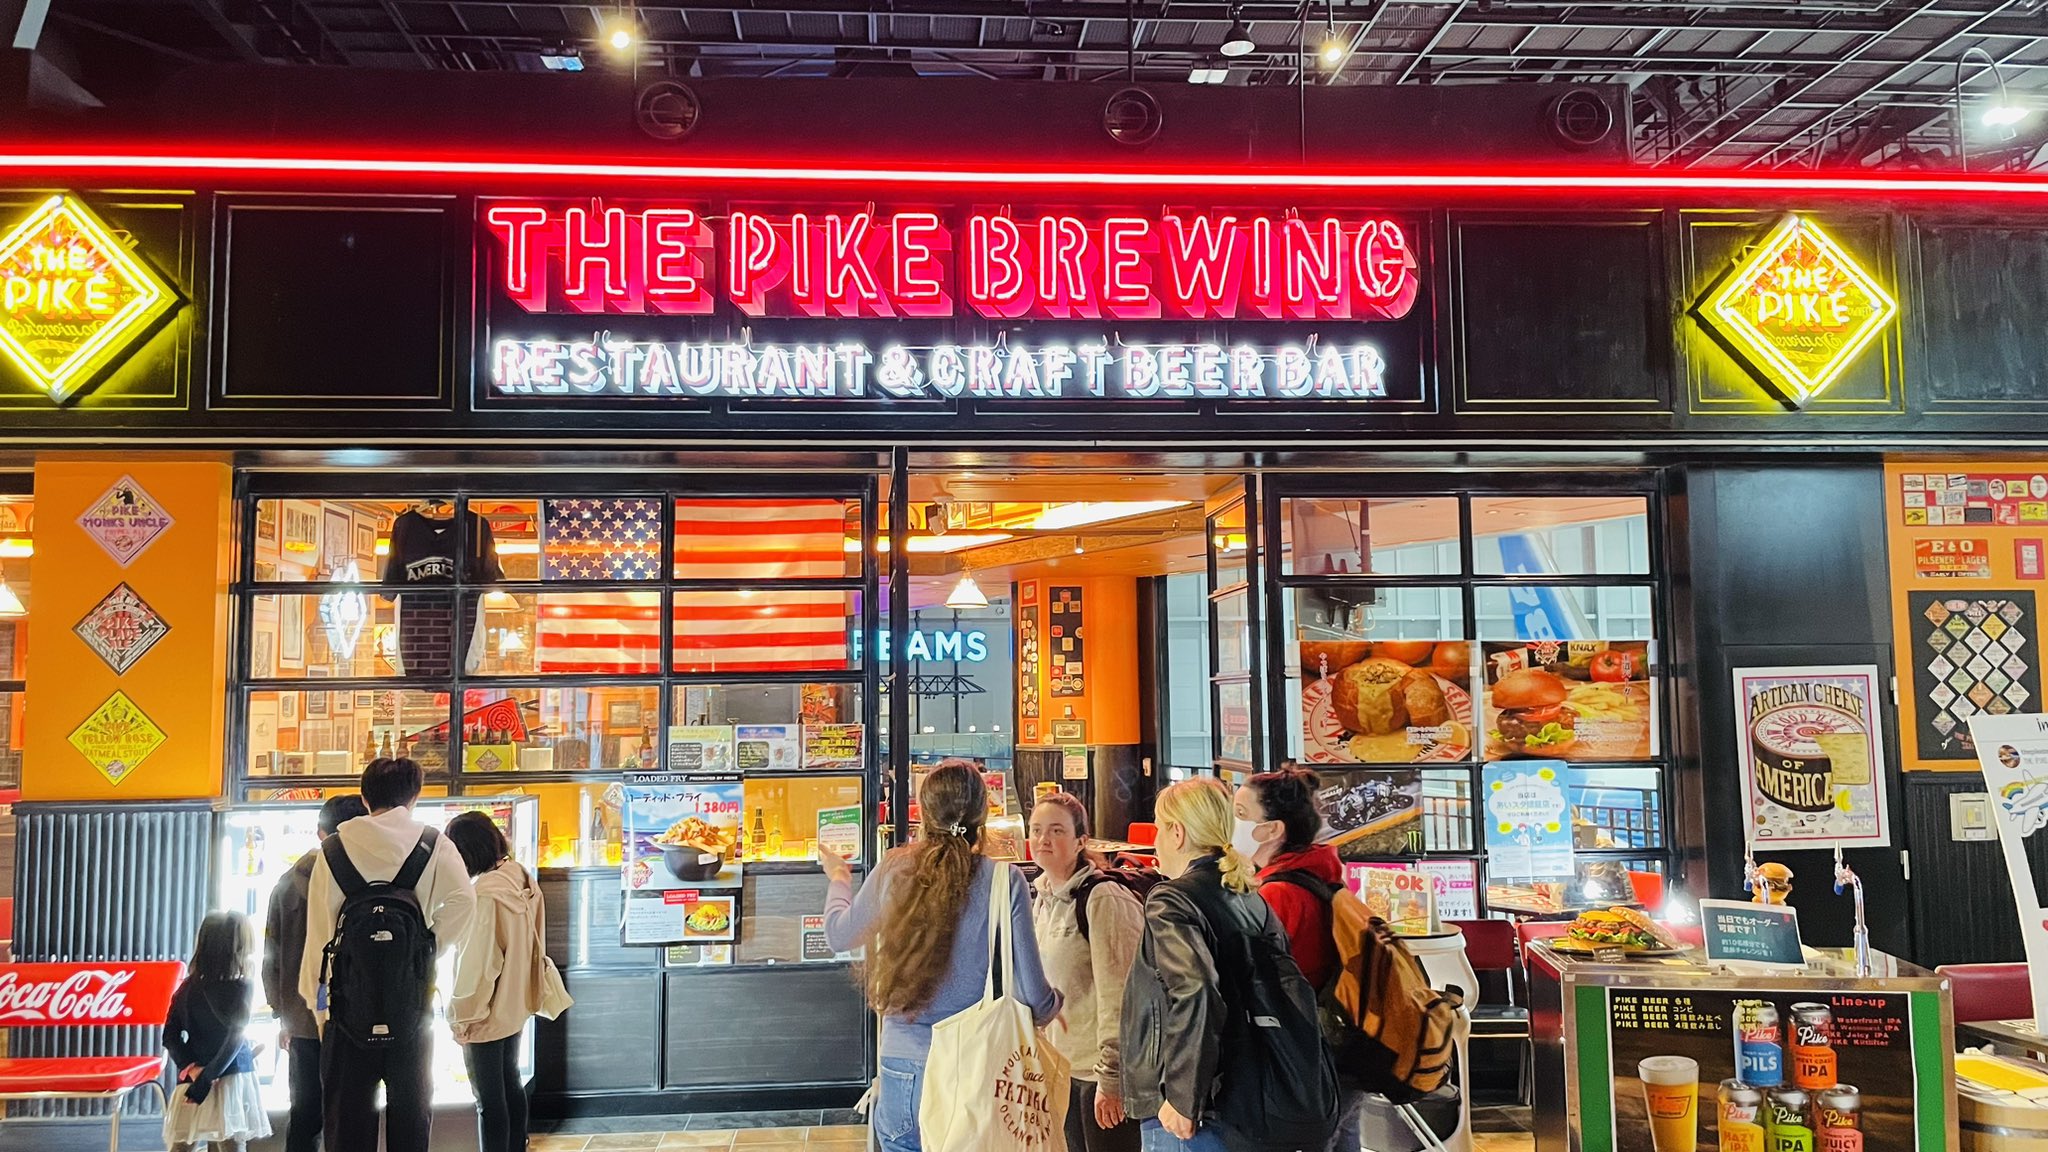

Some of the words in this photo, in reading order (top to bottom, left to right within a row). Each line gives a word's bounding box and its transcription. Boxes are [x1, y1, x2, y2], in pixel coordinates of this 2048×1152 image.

[30, 243, 90, 272] THE
[488, 207, 714, 314] THE
[730, 211, 953, 316] PIKE
[969, 214, 1419, 319] BREWING
[1775, 266, 1829, 293] THE
[4, 270, 112, 313] PIKE
[1758, 291, 1850, 323] PIKE
[493, 340, 872, 396] RESTAURANT
[878, 340, 925, 396] &
[928, 345, 1114, 396] CRAFT
[1123, 345, 1266, 396] BEER
[1276, 345, 1388, 396] BAR
[112, 505, 140, 516] PIKE
[129, 517, 169, 528] UNCLE
[1917, 556, 1955, 565] PILSENER
[1961, 555, 1987, 565] LAGER
[105, 617, 140, 629] PIKE
[99, 628, 143, 640] PLACE
[1570, 643, 1597, 653] KNAX
[1750, 683, 1810, 720] ARTISAN
[1813, 683, 1865, 724] CHEESE
[81, 733, 121, 745] YELLOW
[125, 732, 154, 744] ROSE
[83, 748, 122, 759] OATMEAL
[123, 748, 149, 758] STOUT
[1782, 759, 1805, 770] OF
[633, 774, 669, 783] LOADED
[670, 774, 688, 783] FRY
[1755, 756, 1835, 809] AMERICA
[1394, 874, 1424, 892] OK
[1717, 914, 1779, 927] 当日でもオーダー
[1615, 996, 1638, 1004] PIKE
[1643, 997, 1669, 1005] BEER
[1831, 996, 1887, 1009] Line-up
[1641, 1005, 1667, 1013] BEER
[1642, 1013, 1668, 1021] BEER
[1644, 1021, 1670, 1029] BEER
[1745, 1027, 1772, 1043] Pike
[1797, 1025, 1829, 1046] Pike
[1846, 1031, 1870, 1040] Juicy
[1874, 1031, 1889, 1039] IPA
[1742, 1056, 1778, 1072] PILS
[1802, 1064, 1828, 1077] IPA
[1723, 1102, 1751, 1120] Pike
[1773, 1106, 1803, 1124] Pike
[1823, 1109, 1854, 1128] Pike
[1723, 1131, 1755, 1141] HAZY
[1775, 1139, 1805, 1152] IPA
[1824, 1139, 1857, 1149] JUICY
